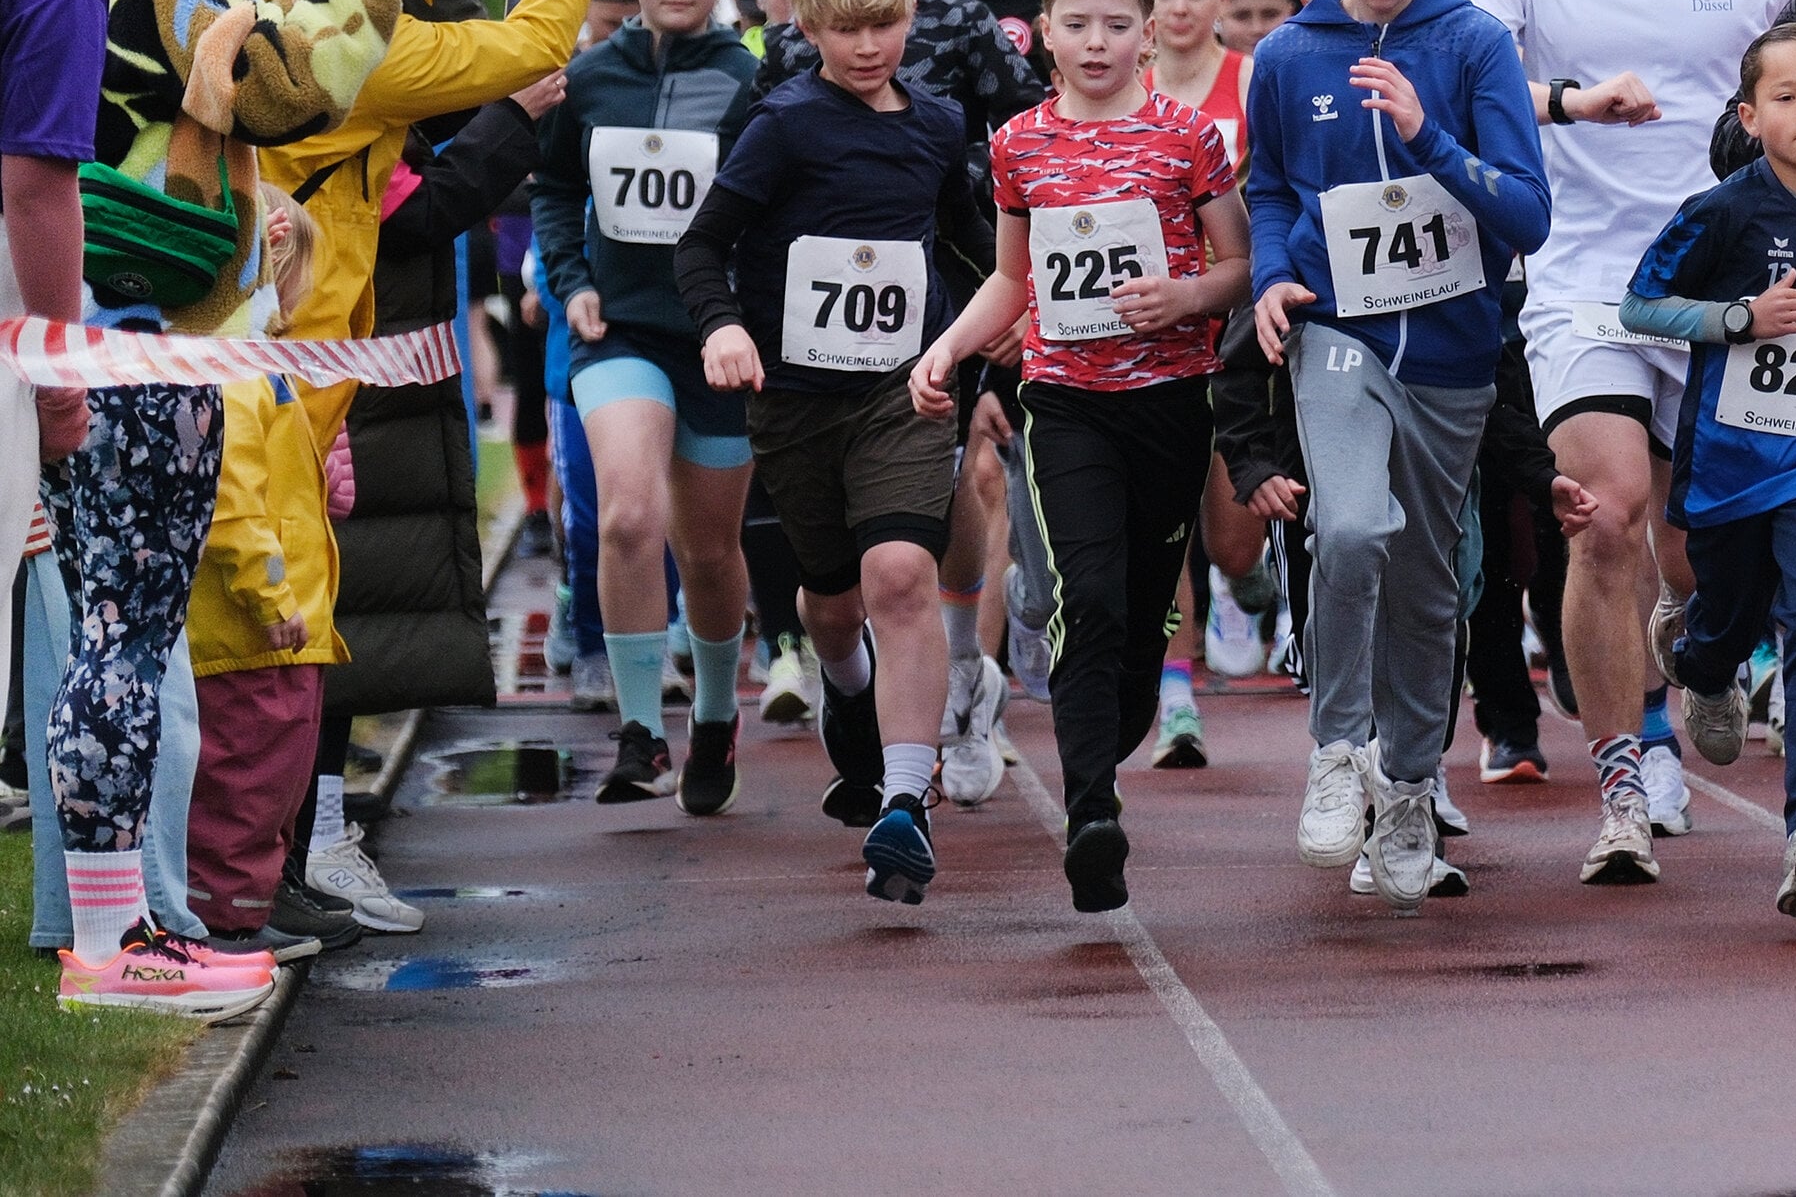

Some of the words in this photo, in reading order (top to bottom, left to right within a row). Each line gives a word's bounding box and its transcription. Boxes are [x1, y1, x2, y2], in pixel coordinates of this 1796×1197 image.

[1312, 110, 1338, 122] hummel
[610, 167, 695, 211] 700
[1348, 213, 1450, 275] 741
[1767, 248, 1794, 258] erima
[1046, 245, 1143, 301] 225
[811, 280, 907, 334] 709
[1363, 281, 1462, 309] SCHWEINELAUF
[807, 348, 900, 367] SCHWEINELAUF
[1326, 346, 1363, 373] LP
[122, 963, 185, 981] HOKA
